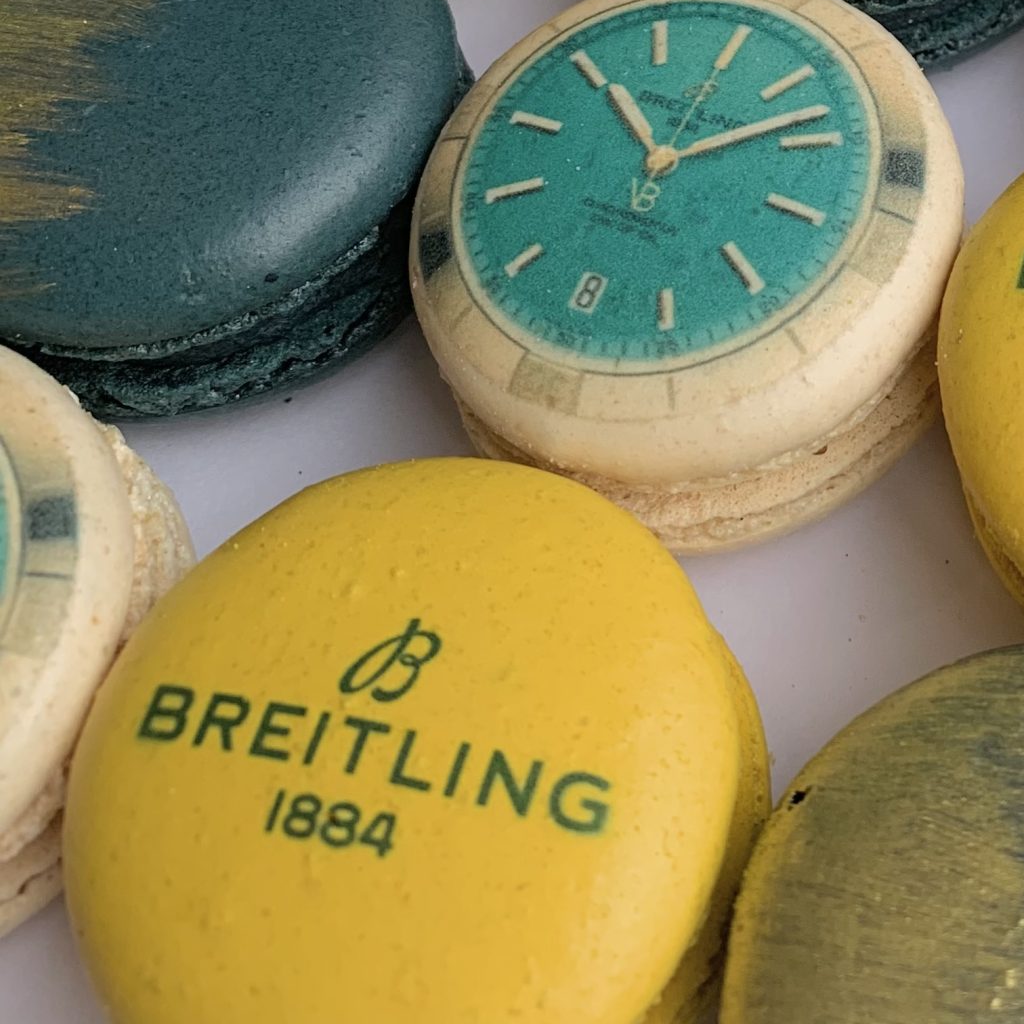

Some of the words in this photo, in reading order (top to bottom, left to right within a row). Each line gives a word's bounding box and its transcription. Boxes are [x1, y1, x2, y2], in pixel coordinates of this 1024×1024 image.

[574, 275, 604, 310] 8
[135, 683, 613, 836] BREITLING
[263, 789, 398, 859] 1884
